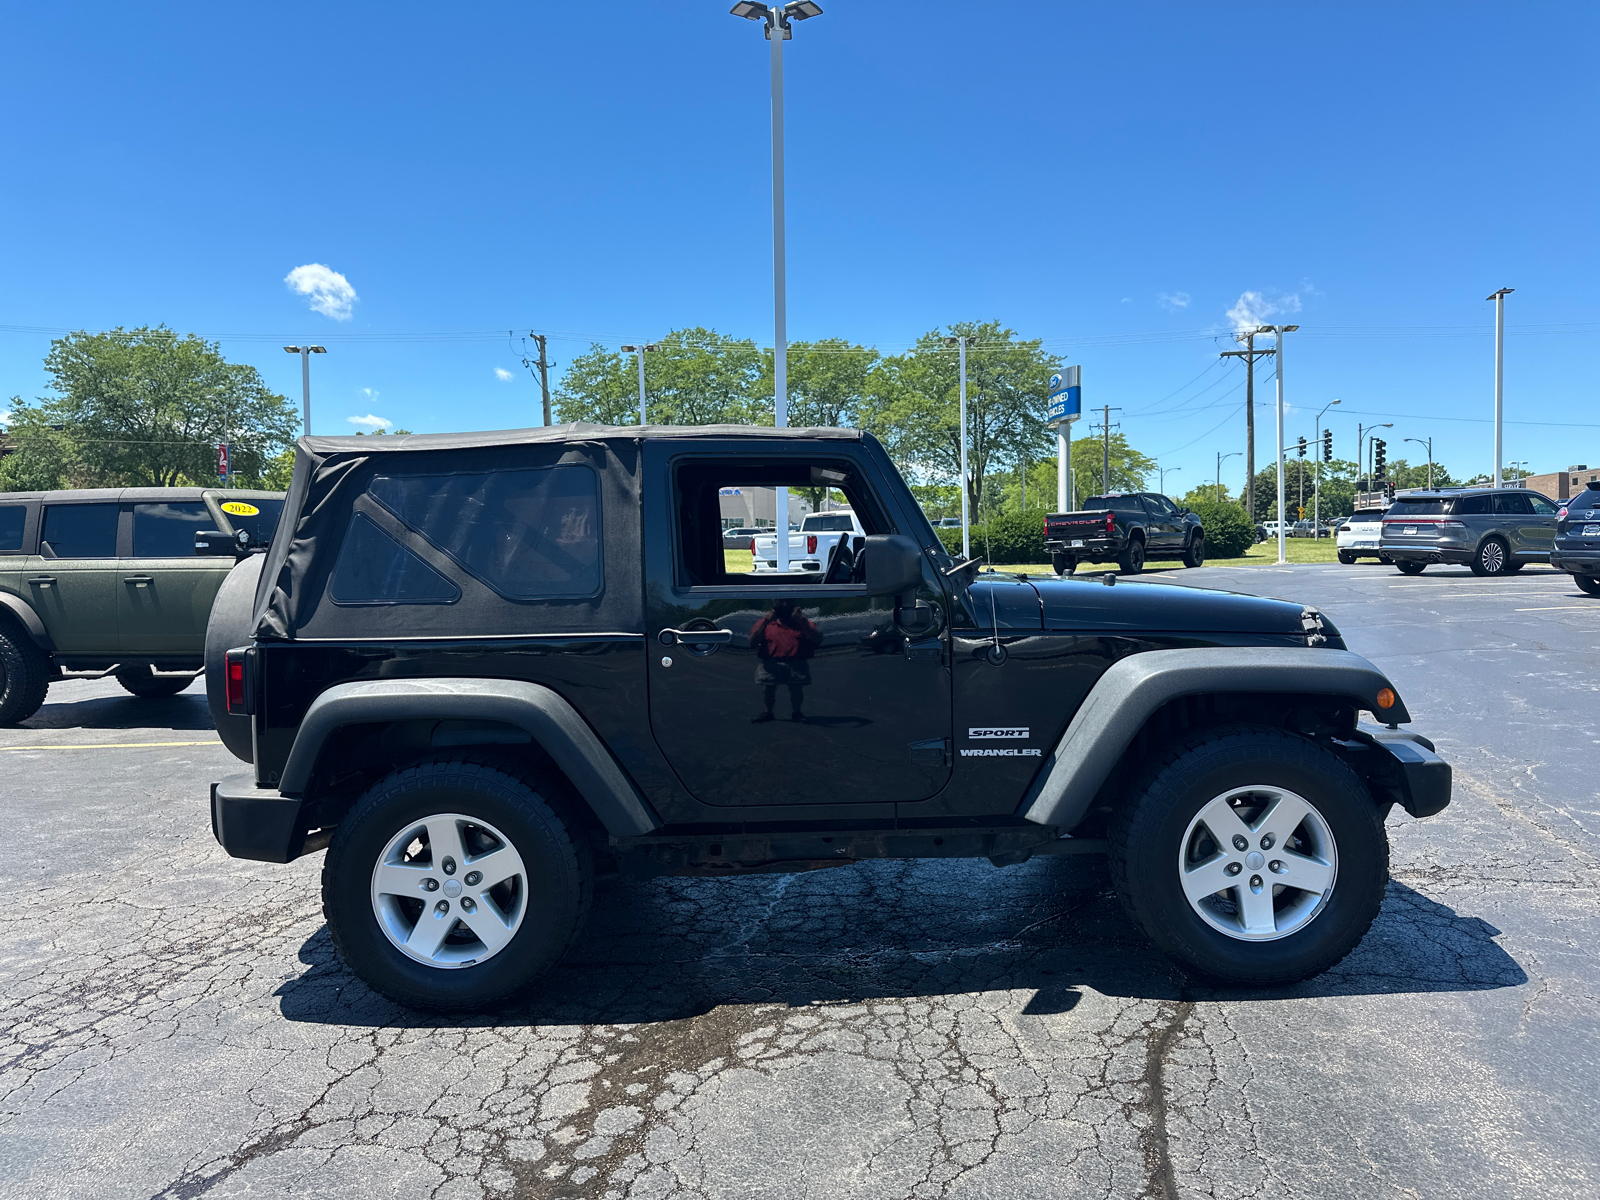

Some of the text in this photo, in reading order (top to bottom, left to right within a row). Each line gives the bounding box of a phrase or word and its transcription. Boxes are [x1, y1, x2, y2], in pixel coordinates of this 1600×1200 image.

[229, 504, 252, 513] 2022
[972, 729, 1025, 737] SPORT
[960, 748, 1042, 757] WRANGLER
